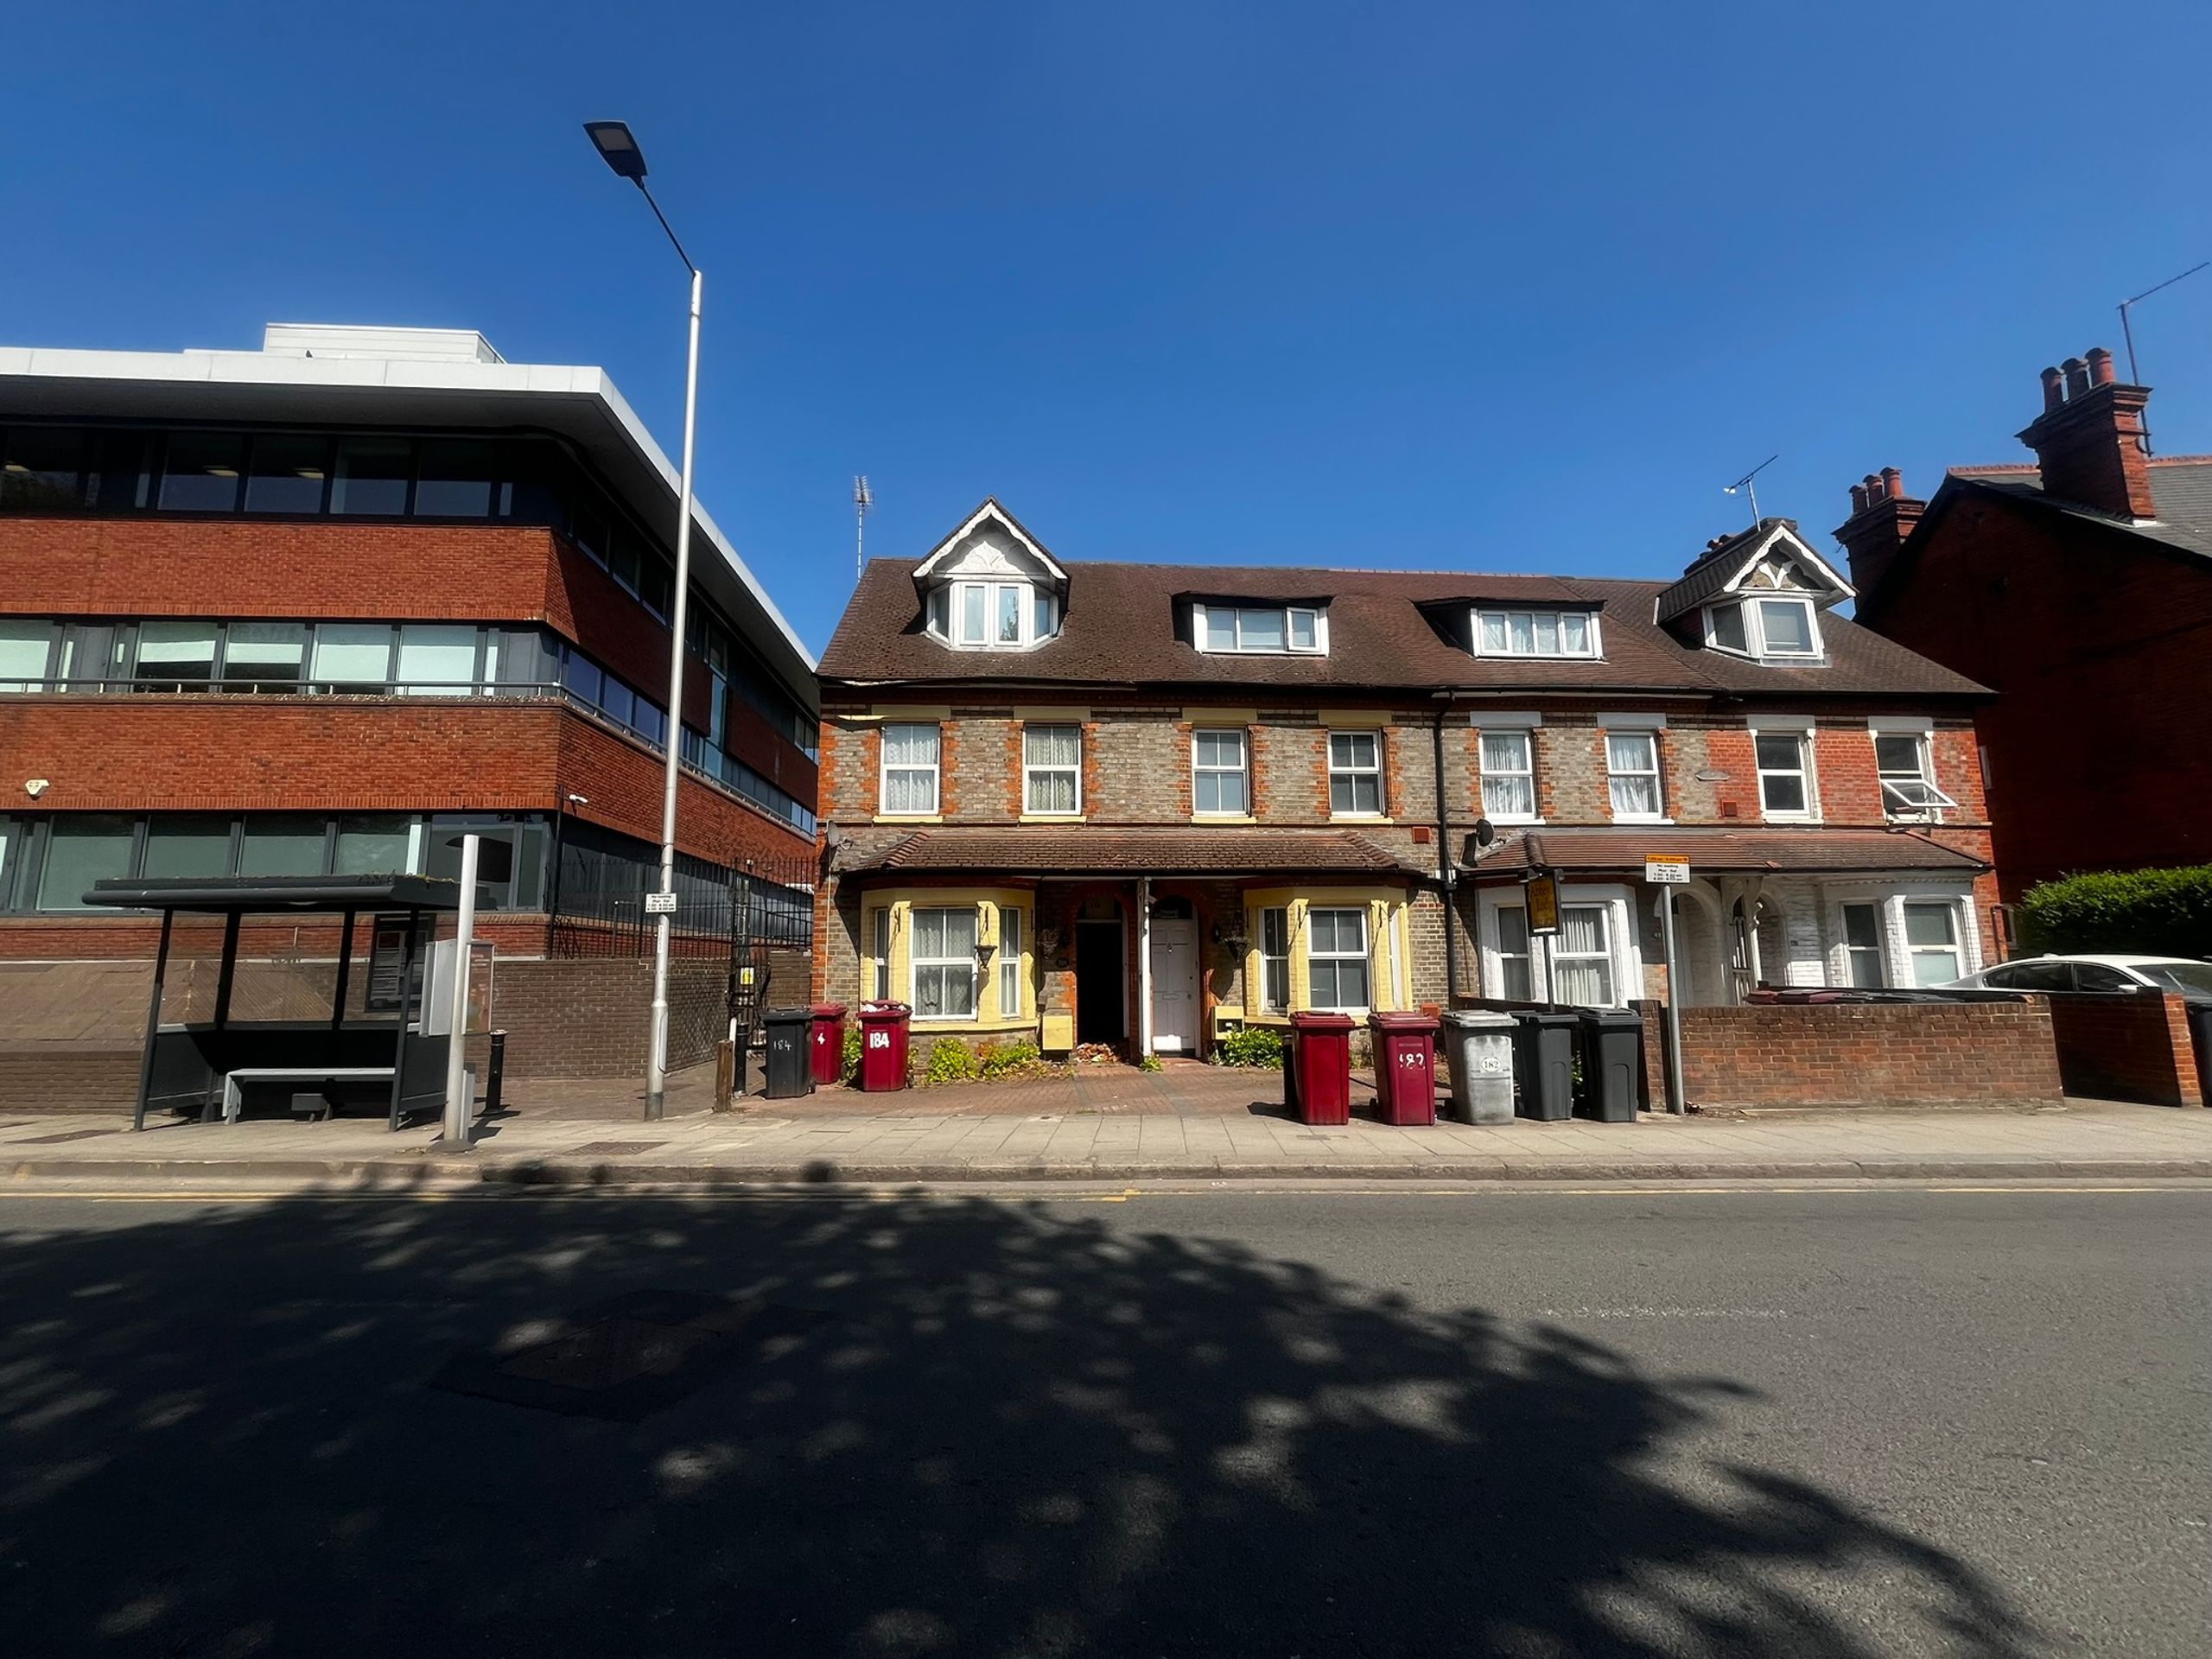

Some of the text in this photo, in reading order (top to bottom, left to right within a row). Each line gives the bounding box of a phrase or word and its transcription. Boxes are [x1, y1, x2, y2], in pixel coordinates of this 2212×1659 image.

[772, 1040, 792, 1051] 184
[869, 1032, 890, 1049] 184
[1484, 1060, 1499, 1069] 182
